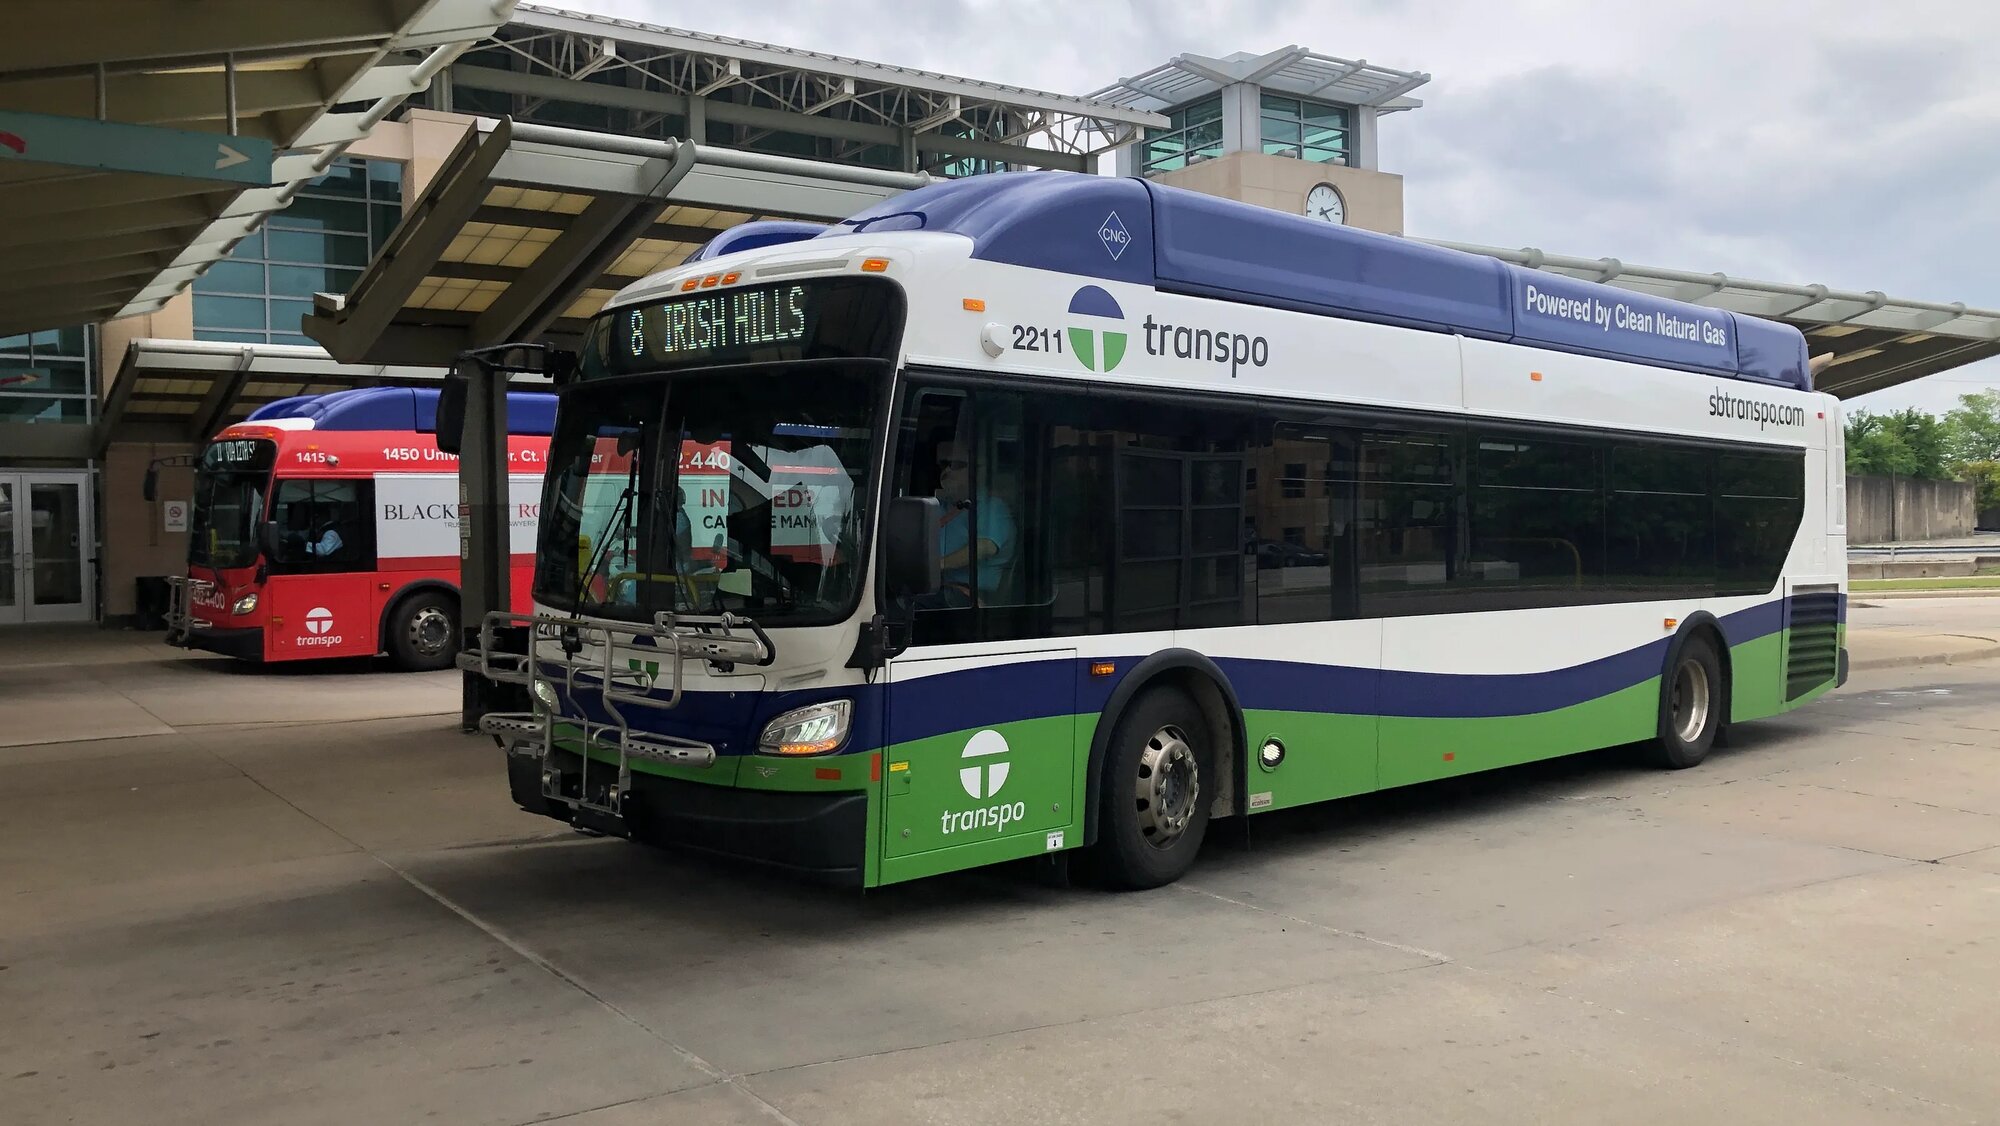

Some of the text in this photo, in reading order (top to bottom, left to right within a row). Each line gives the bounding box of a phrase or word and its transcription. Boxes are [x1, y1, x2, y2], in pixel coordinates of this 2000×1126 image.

[1103, 228, 1126, 244] CNG
[631, 286, 805, 356] 8 IRISH HILLS
[1527, 284, 1726, 346] Powered by Clean Natural Gas
[1012, 324, 1062, 354] 2211
[1142, 314, 1269, 378] transpo
[1709, 386, 1805, 431] sbtranspo.com
[296, 452, 326, 463] 1415
[383, 447, 420, 461] 1450
[521, 450, 540, 461] Ct.
[296, 634, 342, 647] transpo
[941, 801, 1025, 835] transpo
